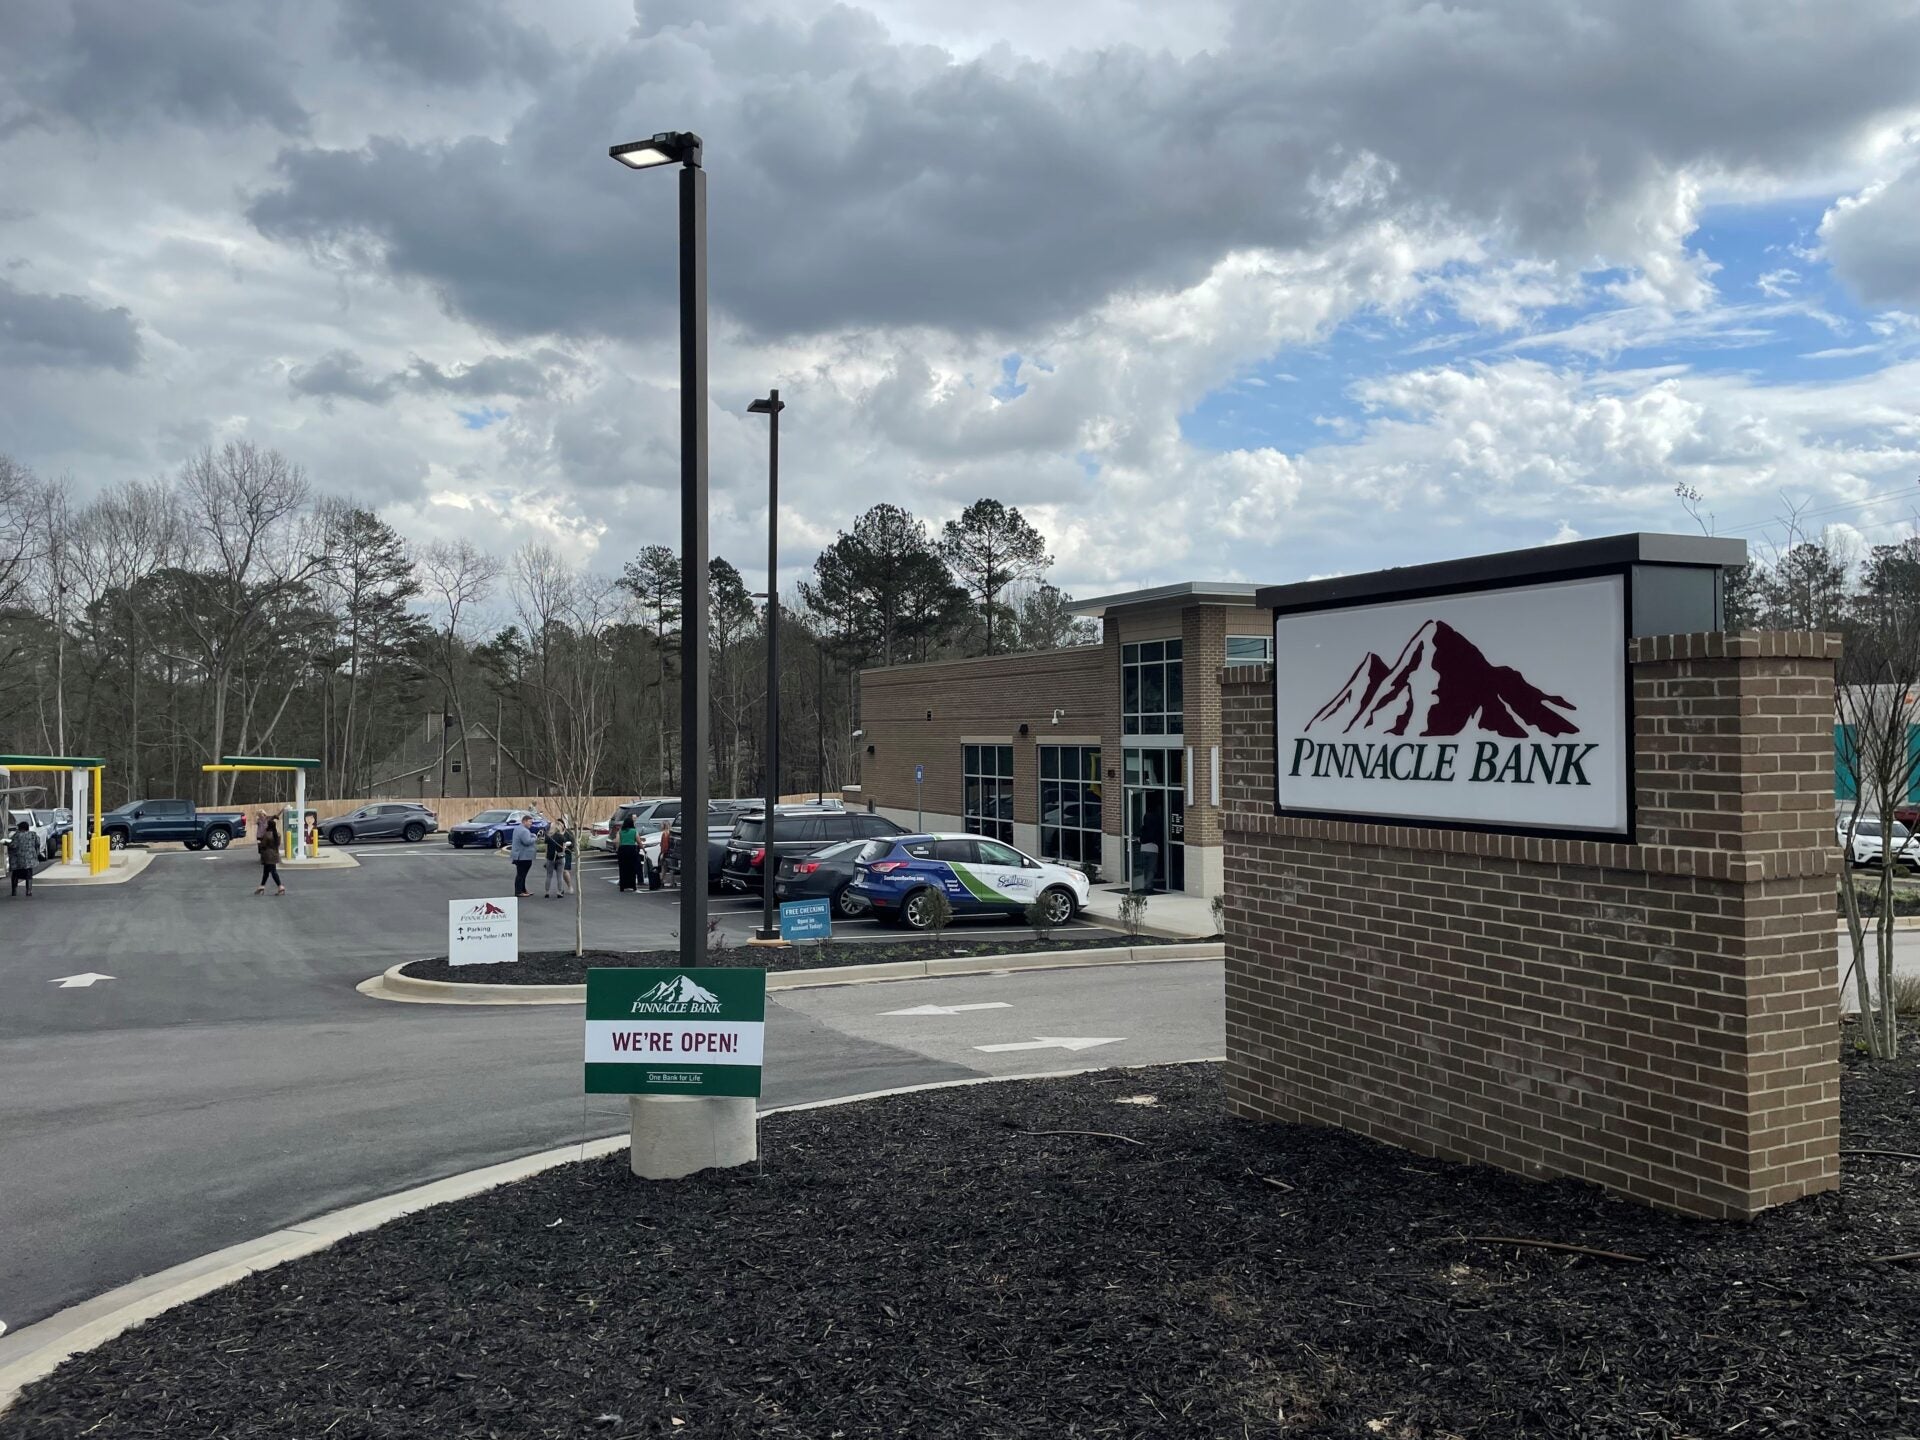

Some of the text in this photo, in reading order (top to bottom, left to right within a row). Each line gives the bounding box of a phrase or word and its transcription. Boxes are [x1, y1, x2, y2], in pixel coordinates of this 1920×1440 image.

[1288, 737, 1599, 785] PINNACLE BANK
[631, 1001, 723, 1014] PINNACLE BANK
[612, 1032, 738, 1052] WE'RE OPEN!
[648, 1073, 661, 1081] One
[689, 1074, 701, 1082] Life
